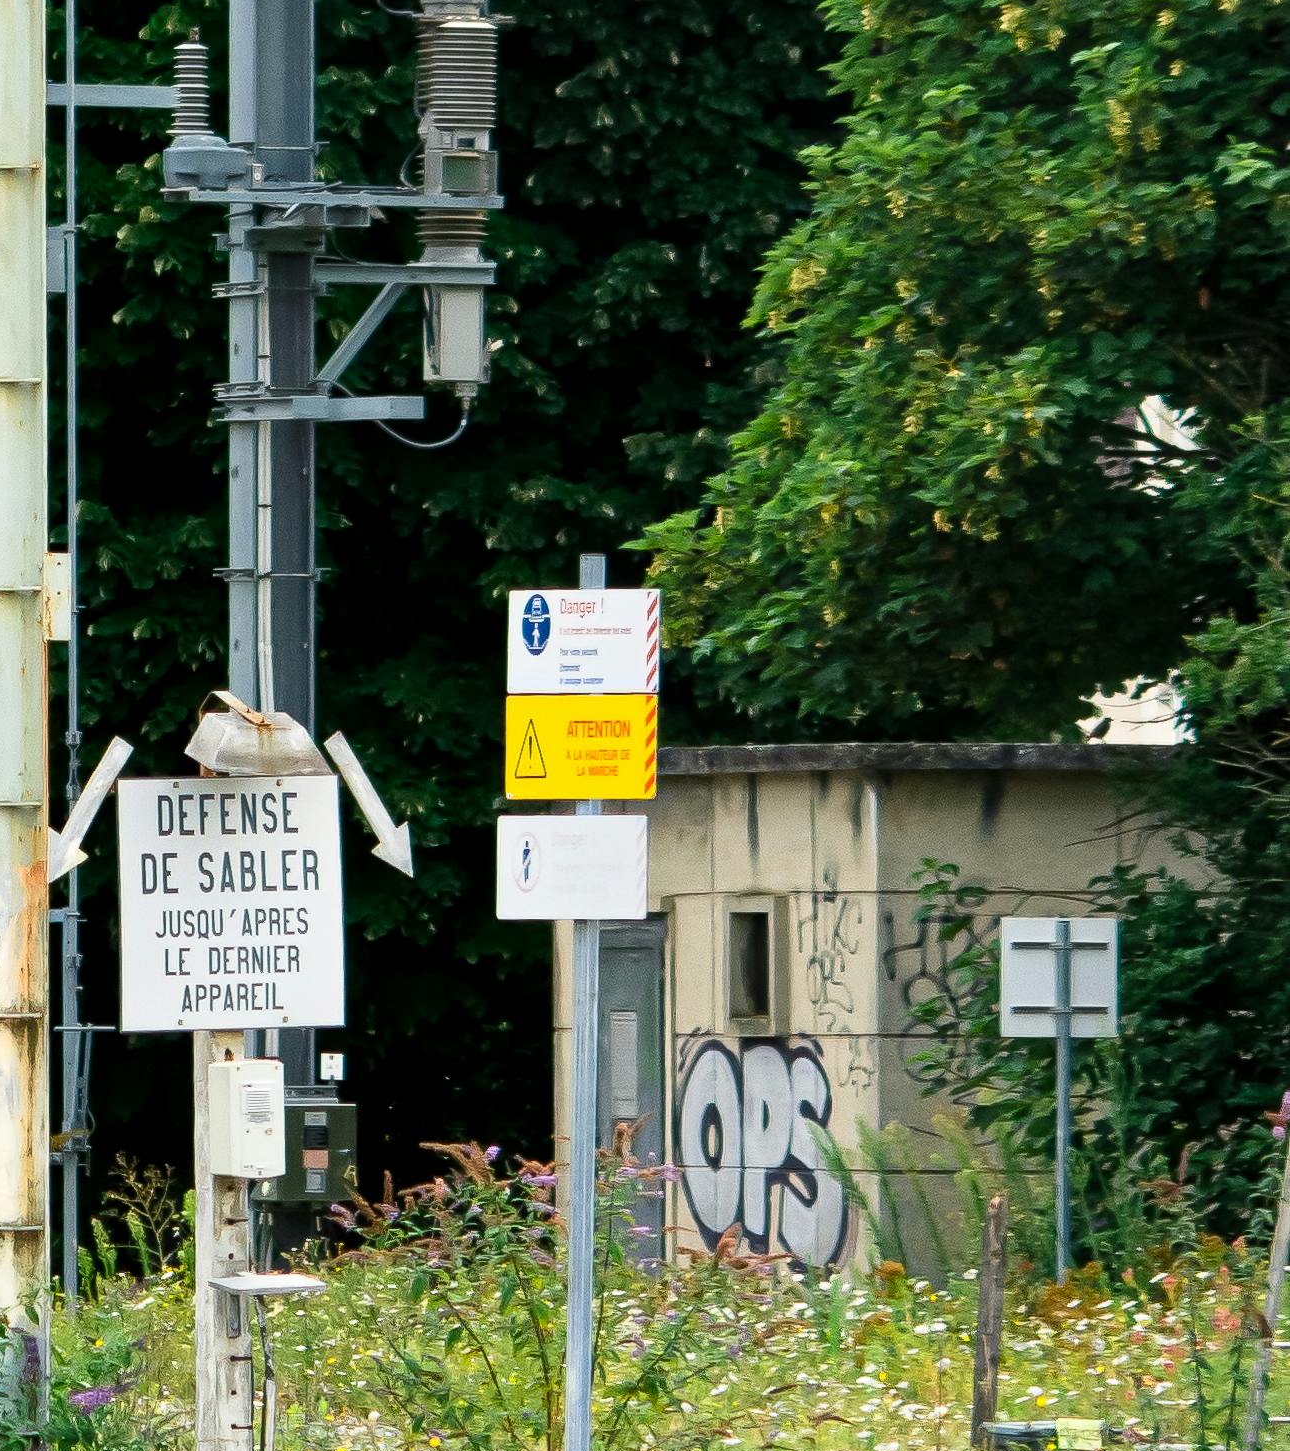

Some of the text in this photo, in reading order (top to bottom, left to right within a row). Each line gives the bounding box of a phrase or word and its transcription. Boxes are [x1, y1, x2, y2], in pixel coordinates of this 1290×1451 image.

[560, 598, 597, 618] Danger
[567, 720, 631, 738] ATTENTION
[157, 792, 299, 837] DEFENSE
[140, 849, 320, 895] DE SABLER
[155, 907, 309, 940] JUSQU'APRES
[164, 945, 301, 976] LE DERNIER
[181, 982, 285, 1013] APPAREIL
